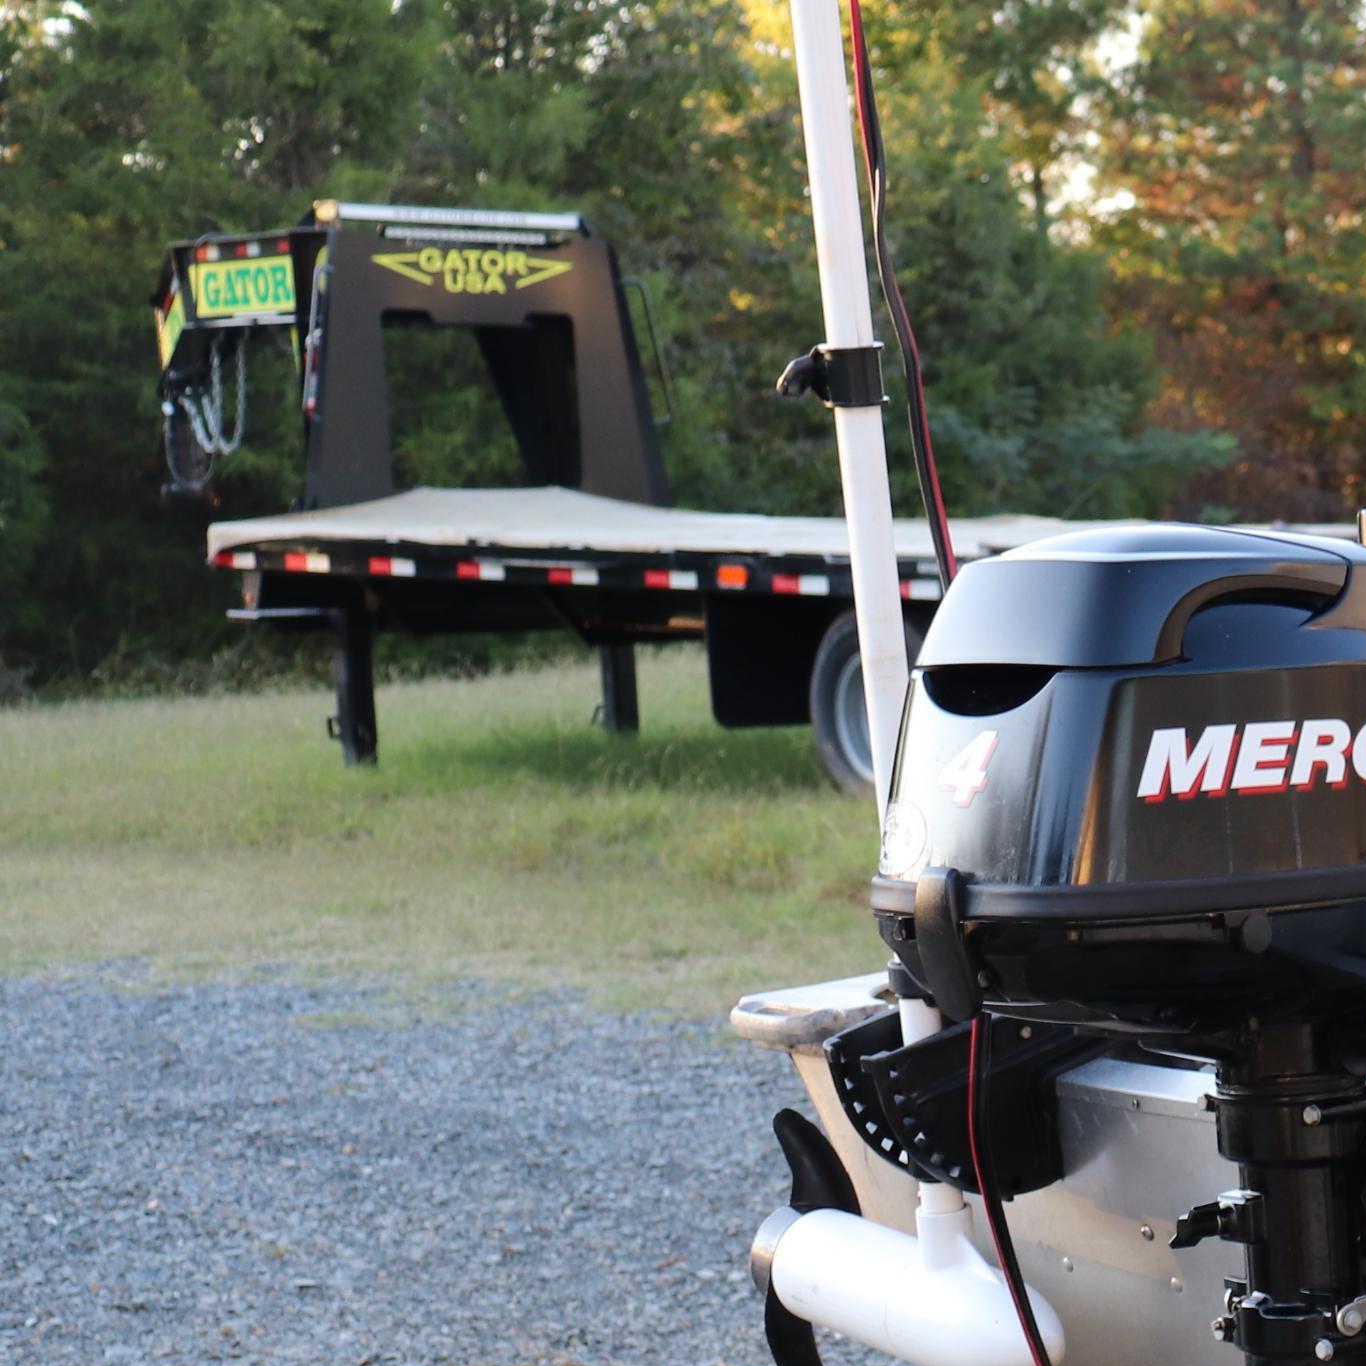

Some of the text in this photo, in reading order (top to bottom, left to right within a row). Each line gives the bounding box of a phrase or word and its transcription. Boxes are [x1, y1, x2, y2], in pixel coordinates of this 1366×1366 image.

[418, 247, 528, 276] GATOR
[204, 264, 293, 309] GATOR
[445, 269, 506, 294] USA
[937, 730, 999, 808] 4
